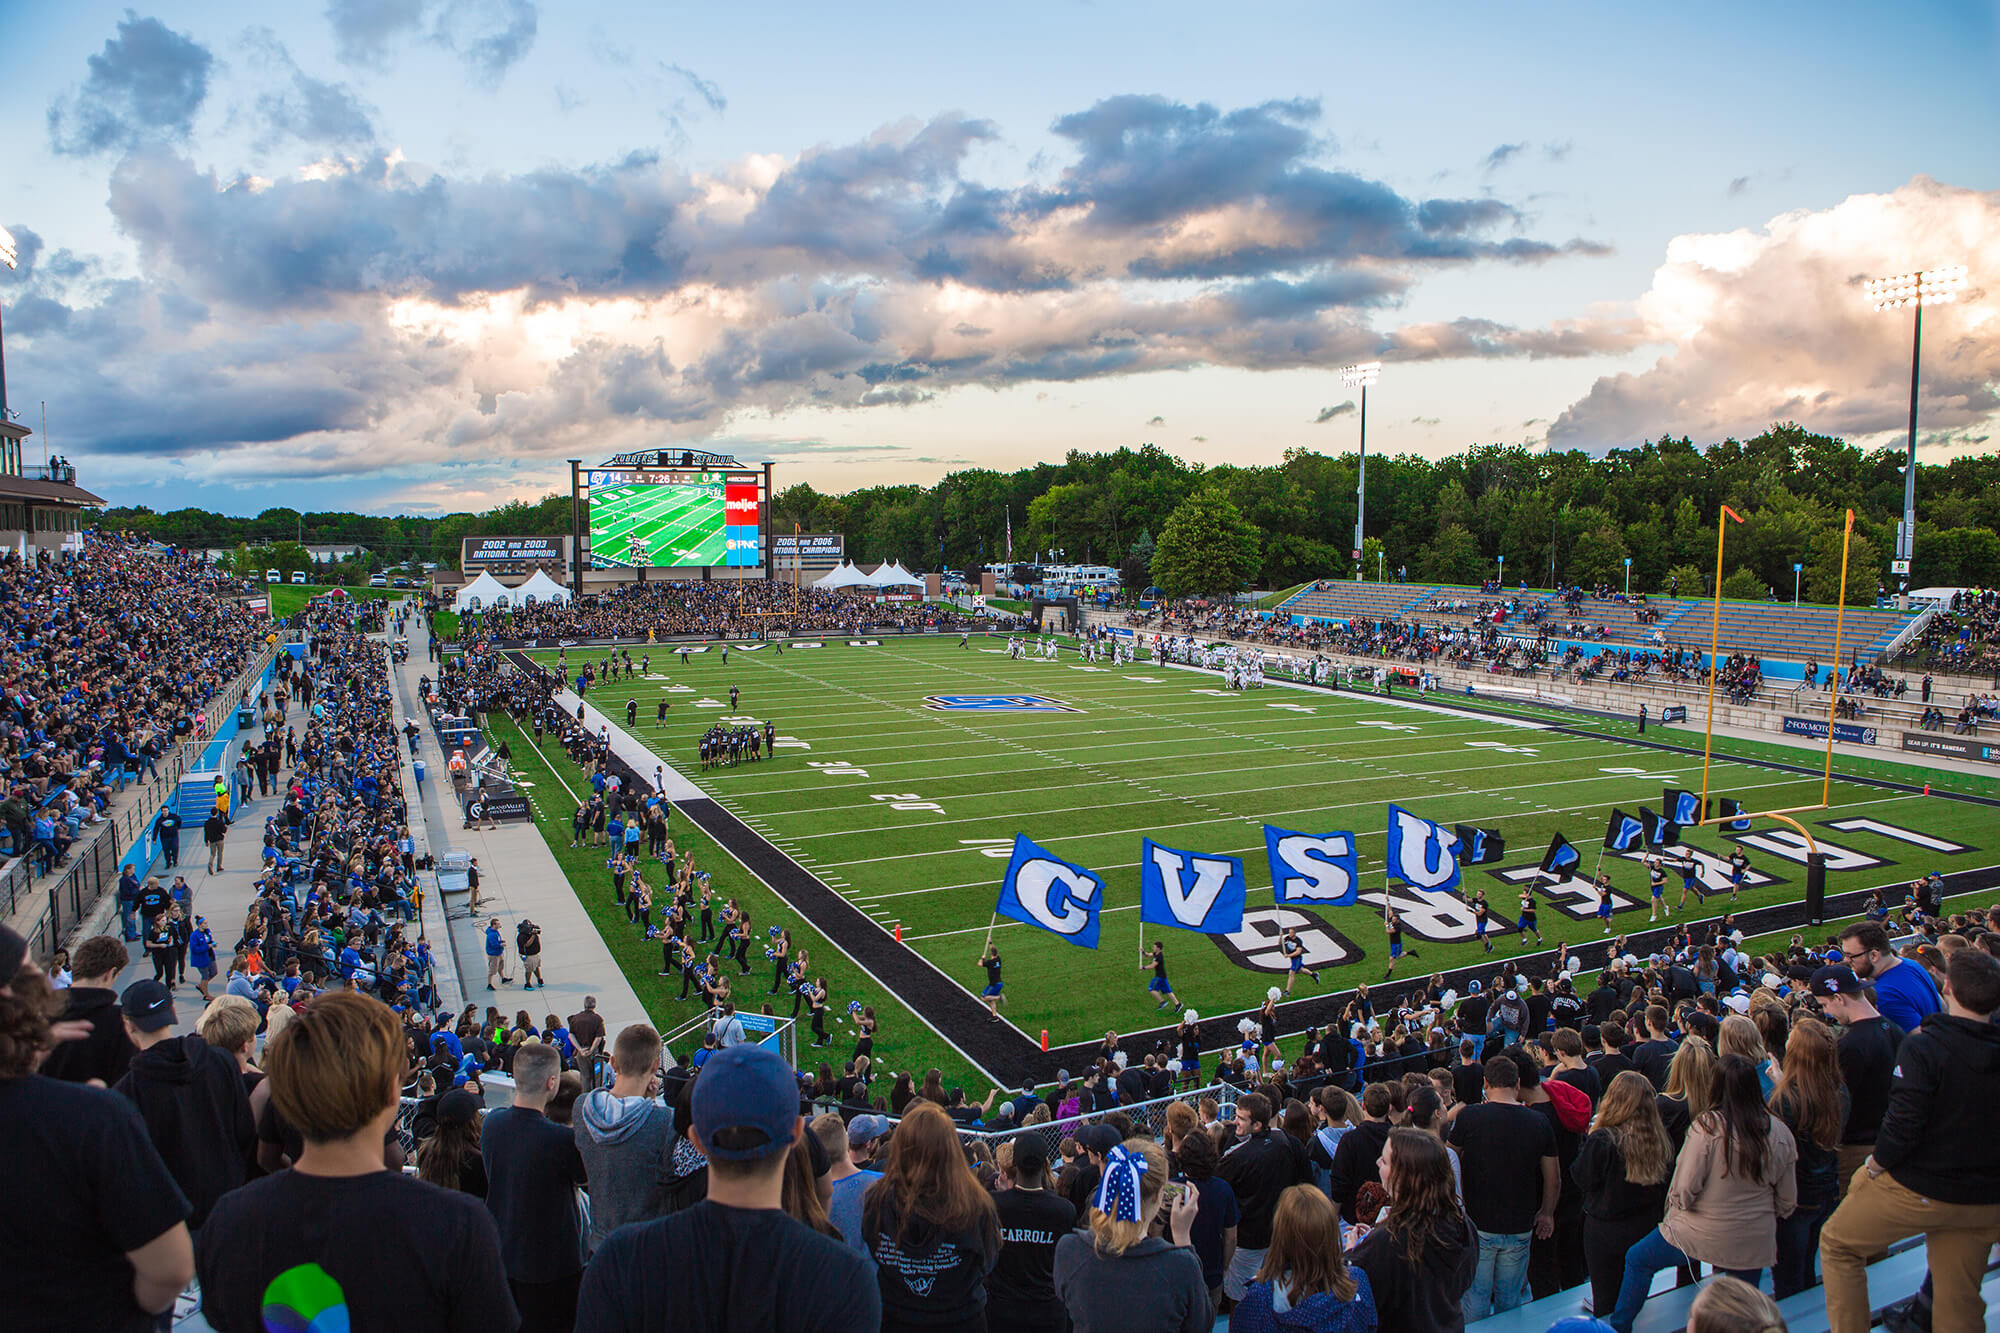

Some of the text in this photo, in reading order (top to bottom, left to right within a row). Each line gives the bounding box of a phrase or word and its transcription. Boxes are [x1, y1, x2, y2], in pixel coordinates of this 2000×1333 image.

[614, 454, 735, 465] LUBBERS STADIUM
[609, 472, 621, 482] 14
[649, 474, 670, 483] 7:26
[702, 473, 709, 483] 0
[726, 498, 758, 512] meijer
[481, 540, 506, 549] 2002
[523, 539, 548, 549] 2003
[737, 540, 758, 549] PNC
[776, 537, 796, 546] 2005
[812, 537, 834, 546] 2006
[472, 549, 557, 559] NATIONAL CHAMPIONS
[801, 546, 841, 554] CHAMPIONS
[1793, 720, 1808, 730] FOX
[1808, 722, 1841, 735] MOTORS
[1907, 739, 1921, 747] GEAR
[870, 793, 946, 815] 20
[1673, 791, 1701, 825] R
[1396, 809, 1460, 890] U
[1277, 835, 1350, 901] S
[1151, 845, 1234, 928] V
[1013, 857, 1097, 936] G
[1000, 1227, 1055, 1244] CARROLL
